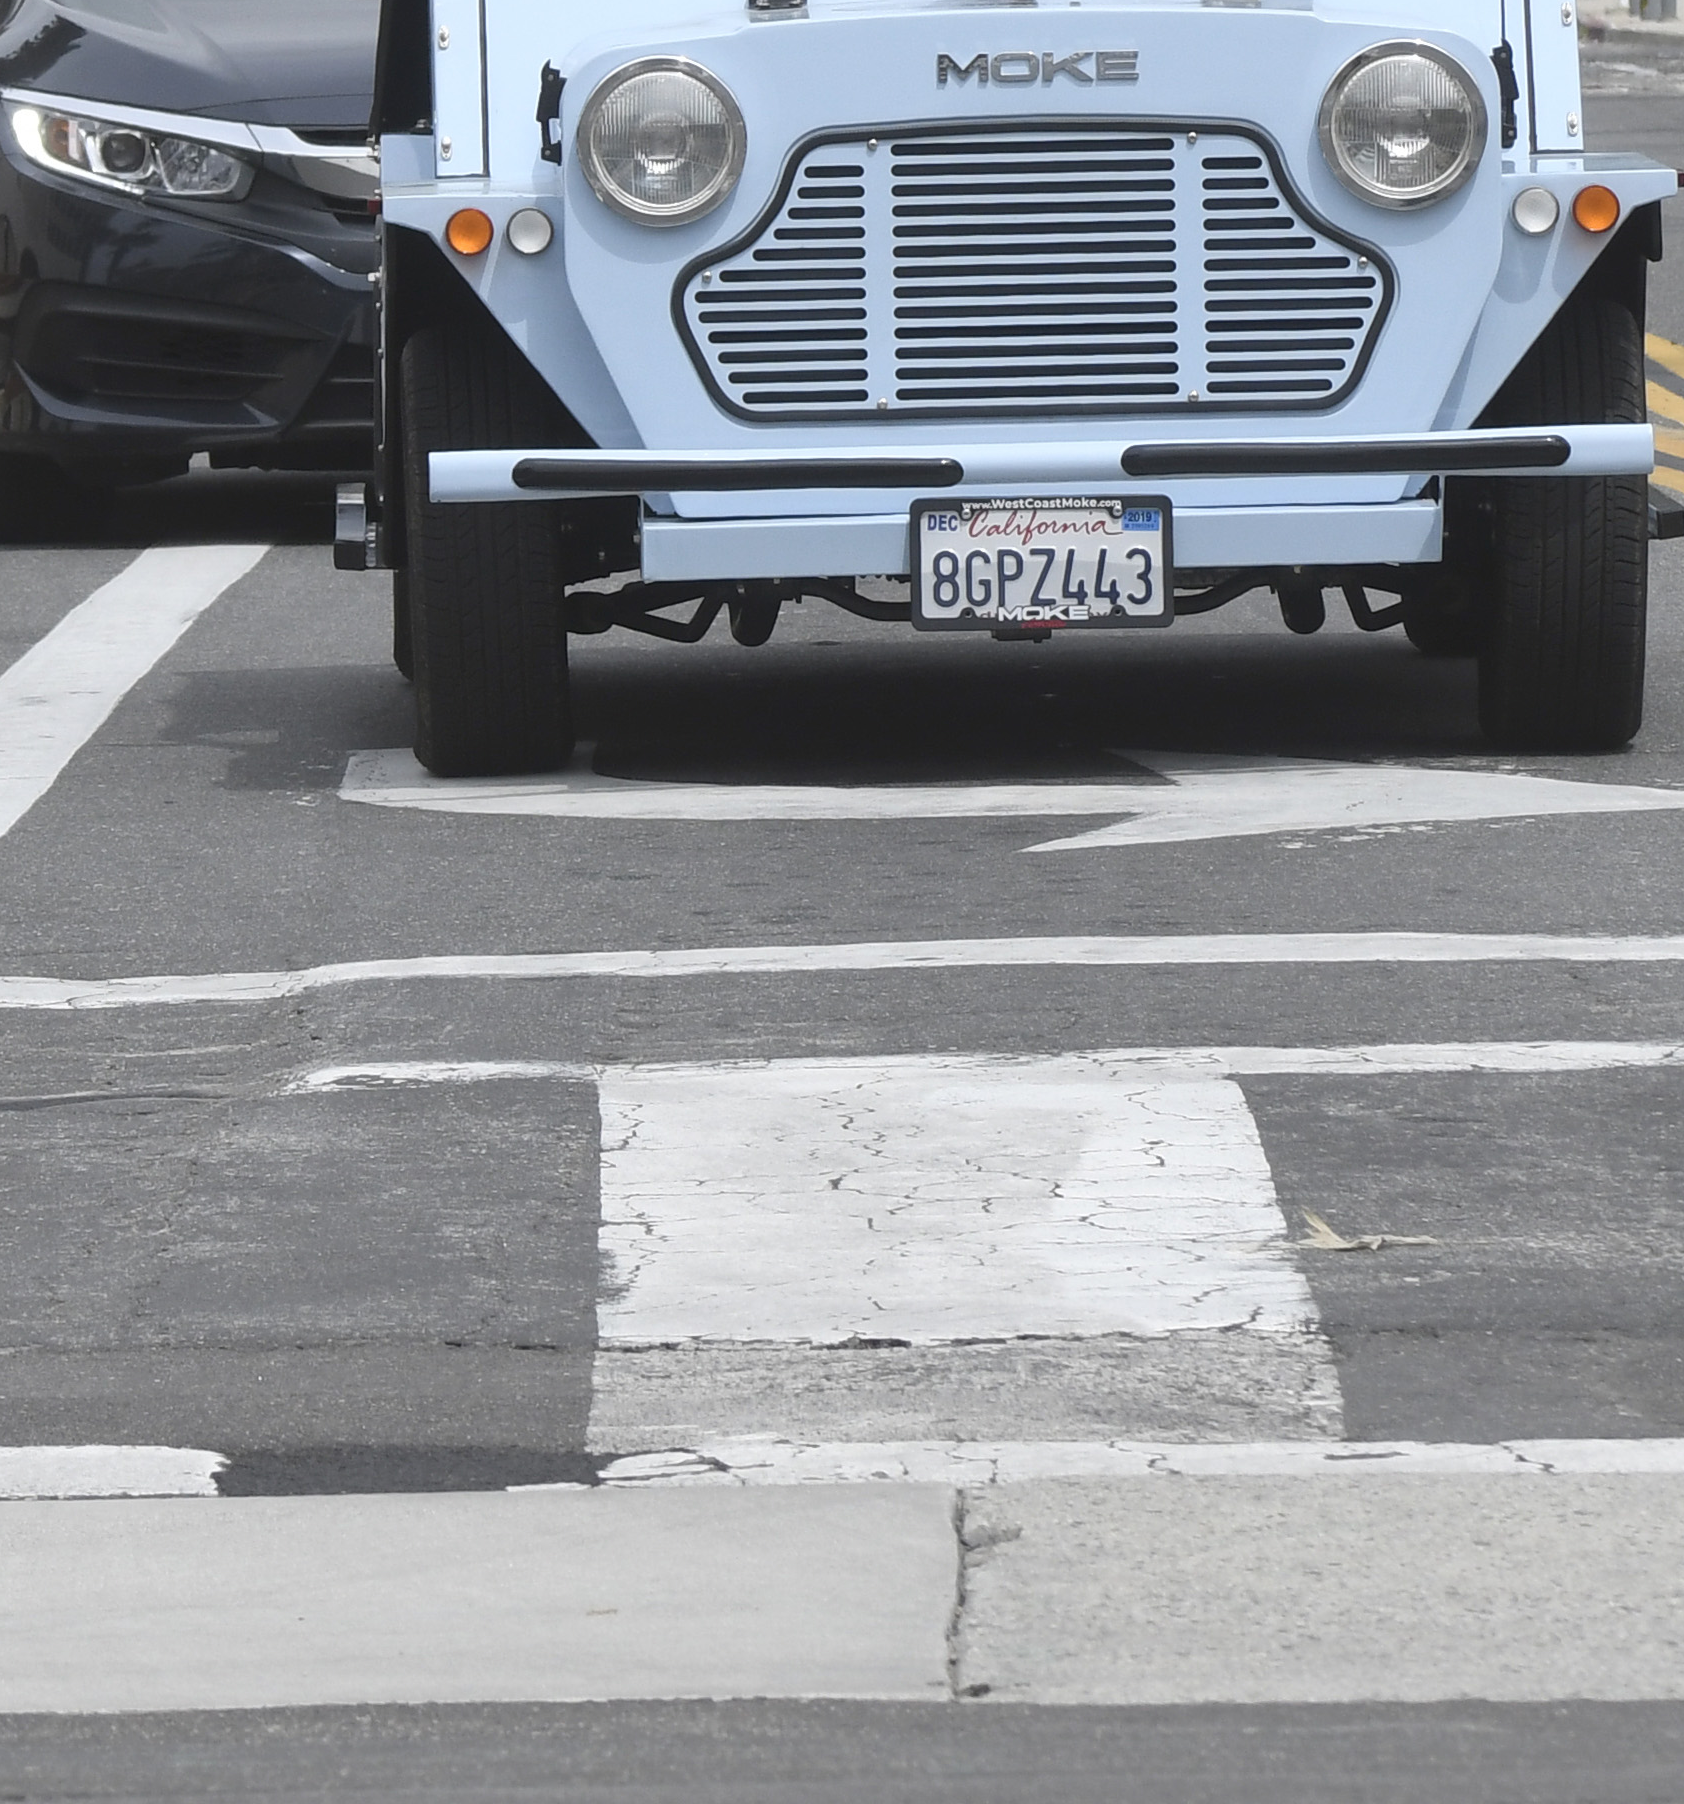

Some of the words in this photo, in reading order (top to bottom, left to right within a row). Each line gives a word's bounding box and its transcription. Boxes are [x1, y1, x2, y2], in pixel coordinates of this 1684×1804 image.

[937, 50, 1139, 85] MOKE
[962, 497, 1122, 510] www.WestCoastMoke.com
[927, 514, 958, 532] DEC
[1128, 511, 1152, 523] 2019
[968, 510, 1123, 546] California
[933, 547, 1153, 608] 8GPZ443
[998, 605, 1090, 622] MOKE
